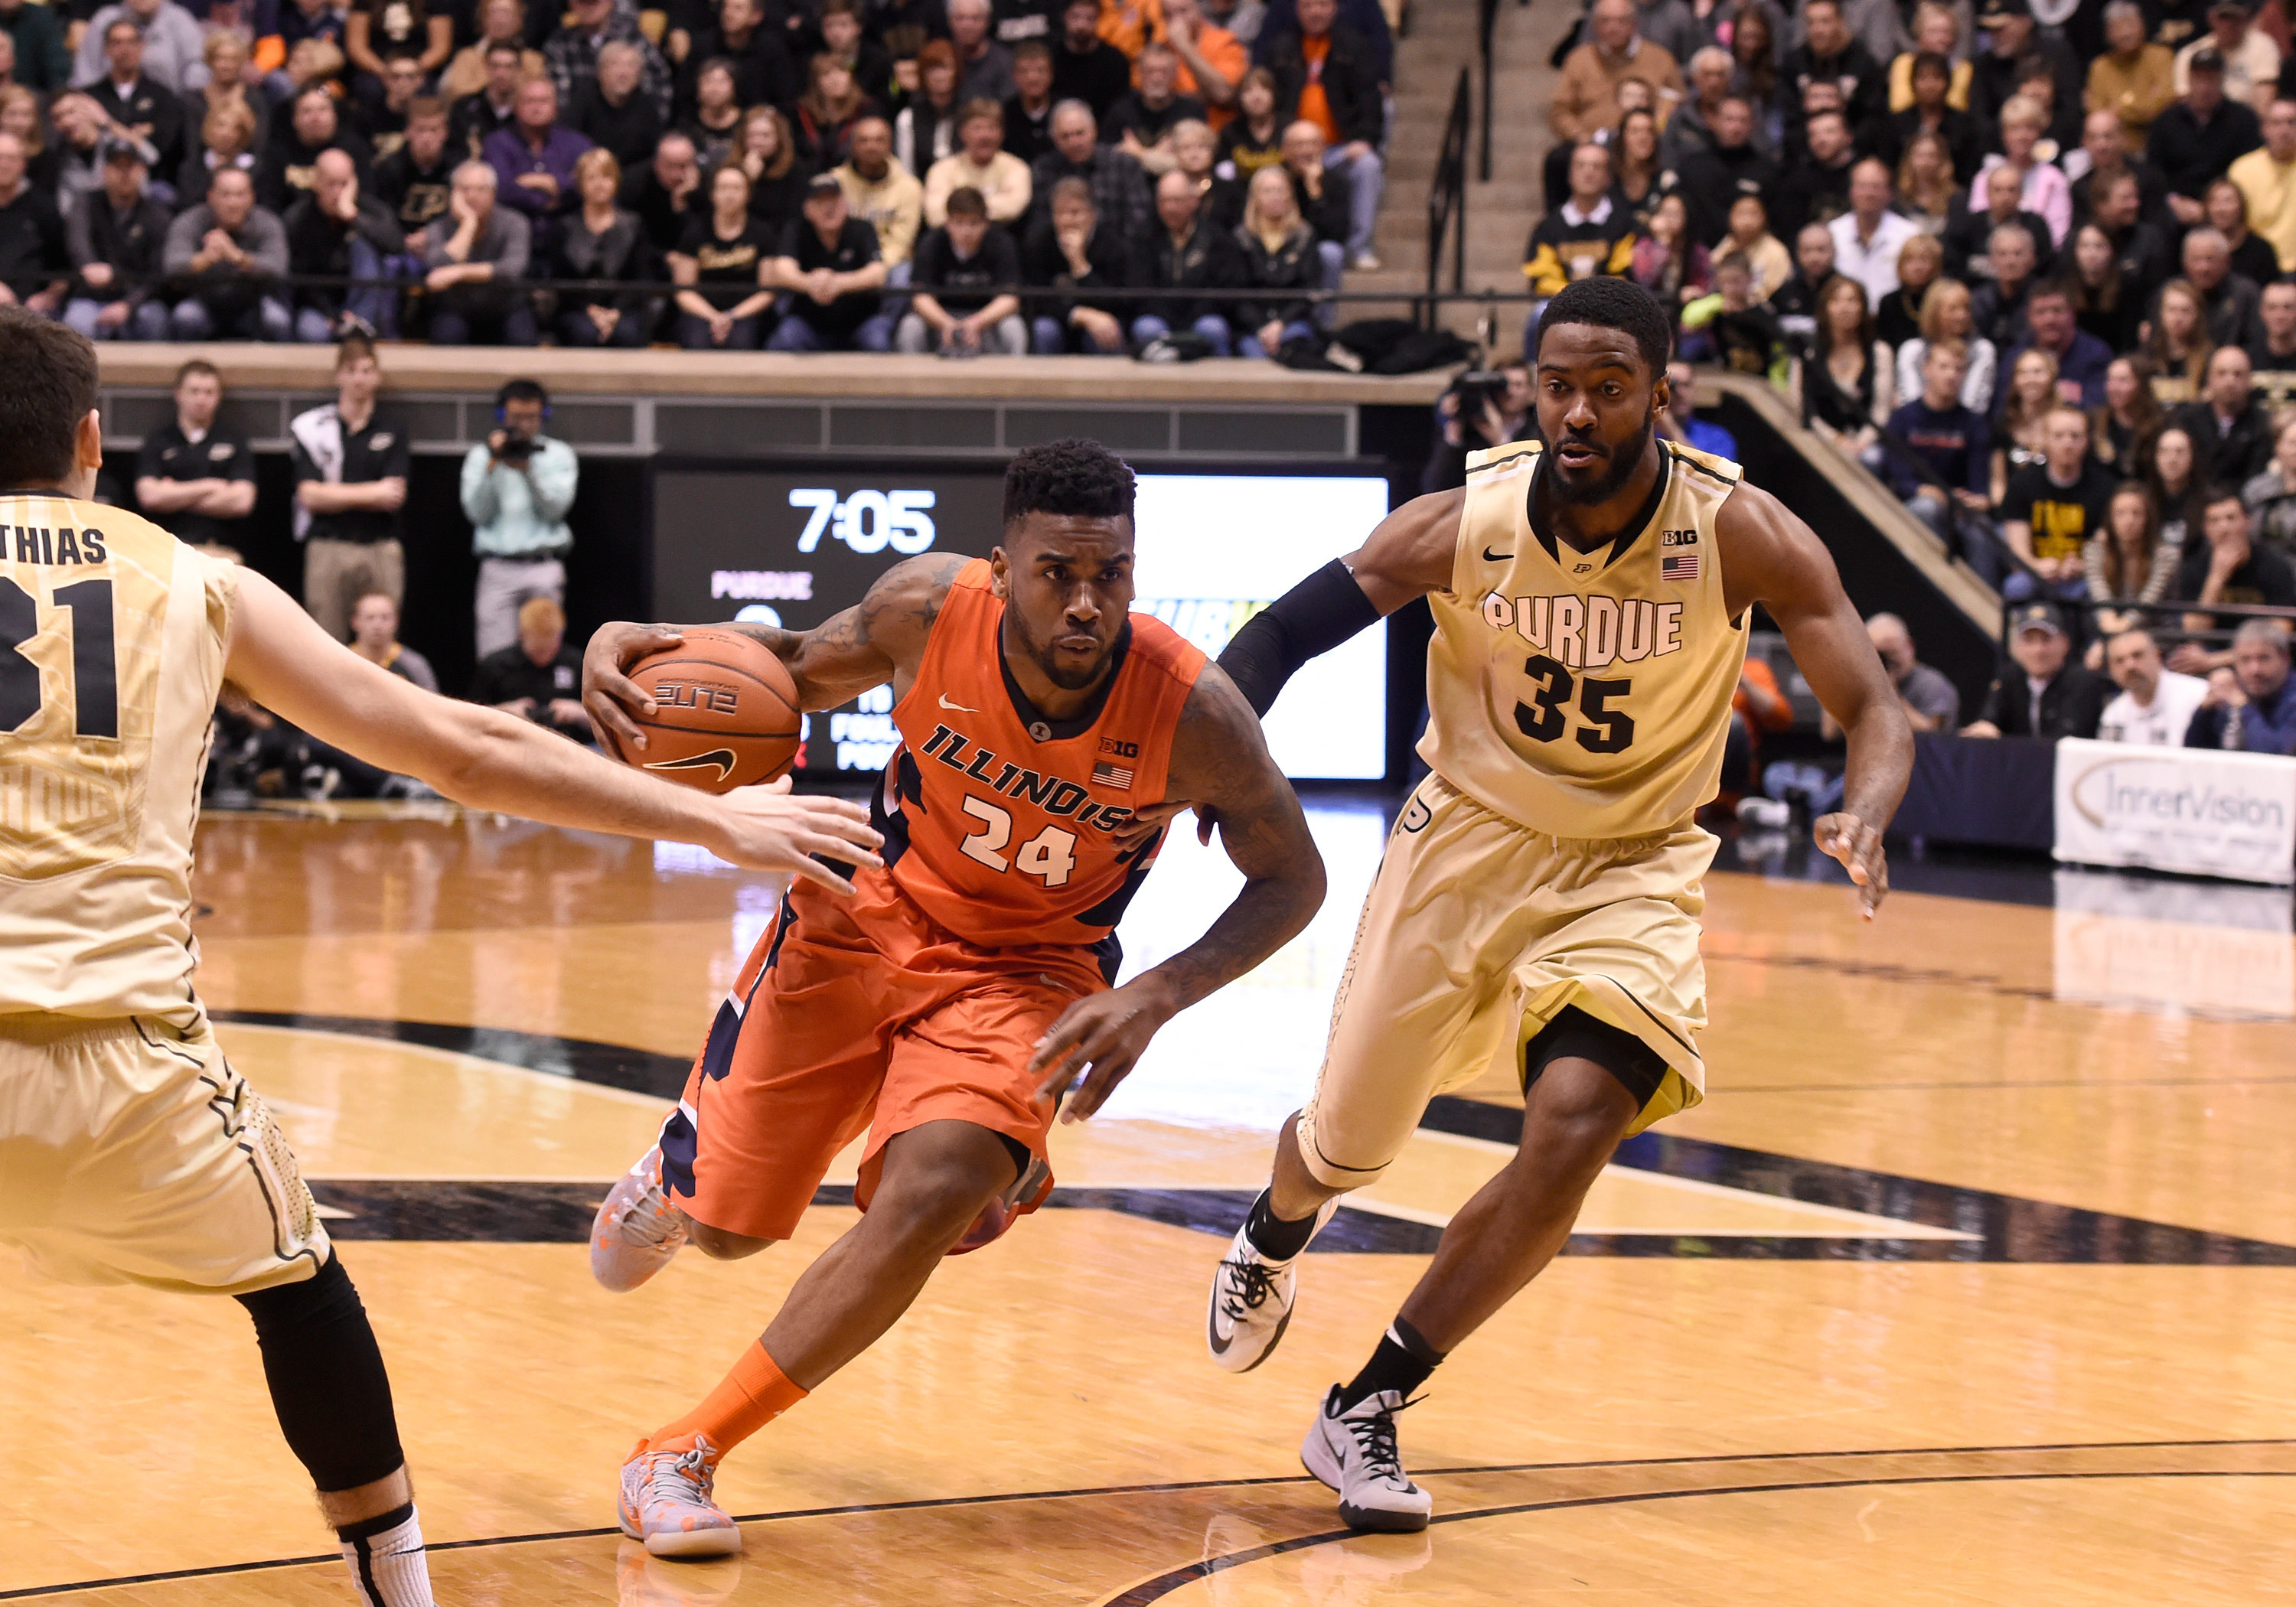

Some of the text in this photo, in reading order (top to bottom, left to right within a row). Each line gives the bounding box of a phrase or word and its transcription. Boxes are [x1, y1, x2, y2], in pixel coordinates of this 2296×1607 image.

[789, 488, 935, 554] 7:05
[711, 570, 813, 600] PURDUE
[1482, 591, 1683, 668] PURDUE
[655, 684, 738, 715] ELITE
[1514, 654, 1635, 754] 35
[919, 722, 1135, 833] ILLINOIS
[2106, 771, 2284, 828] InnerVision
[959, 792, 1078, 888] 24
